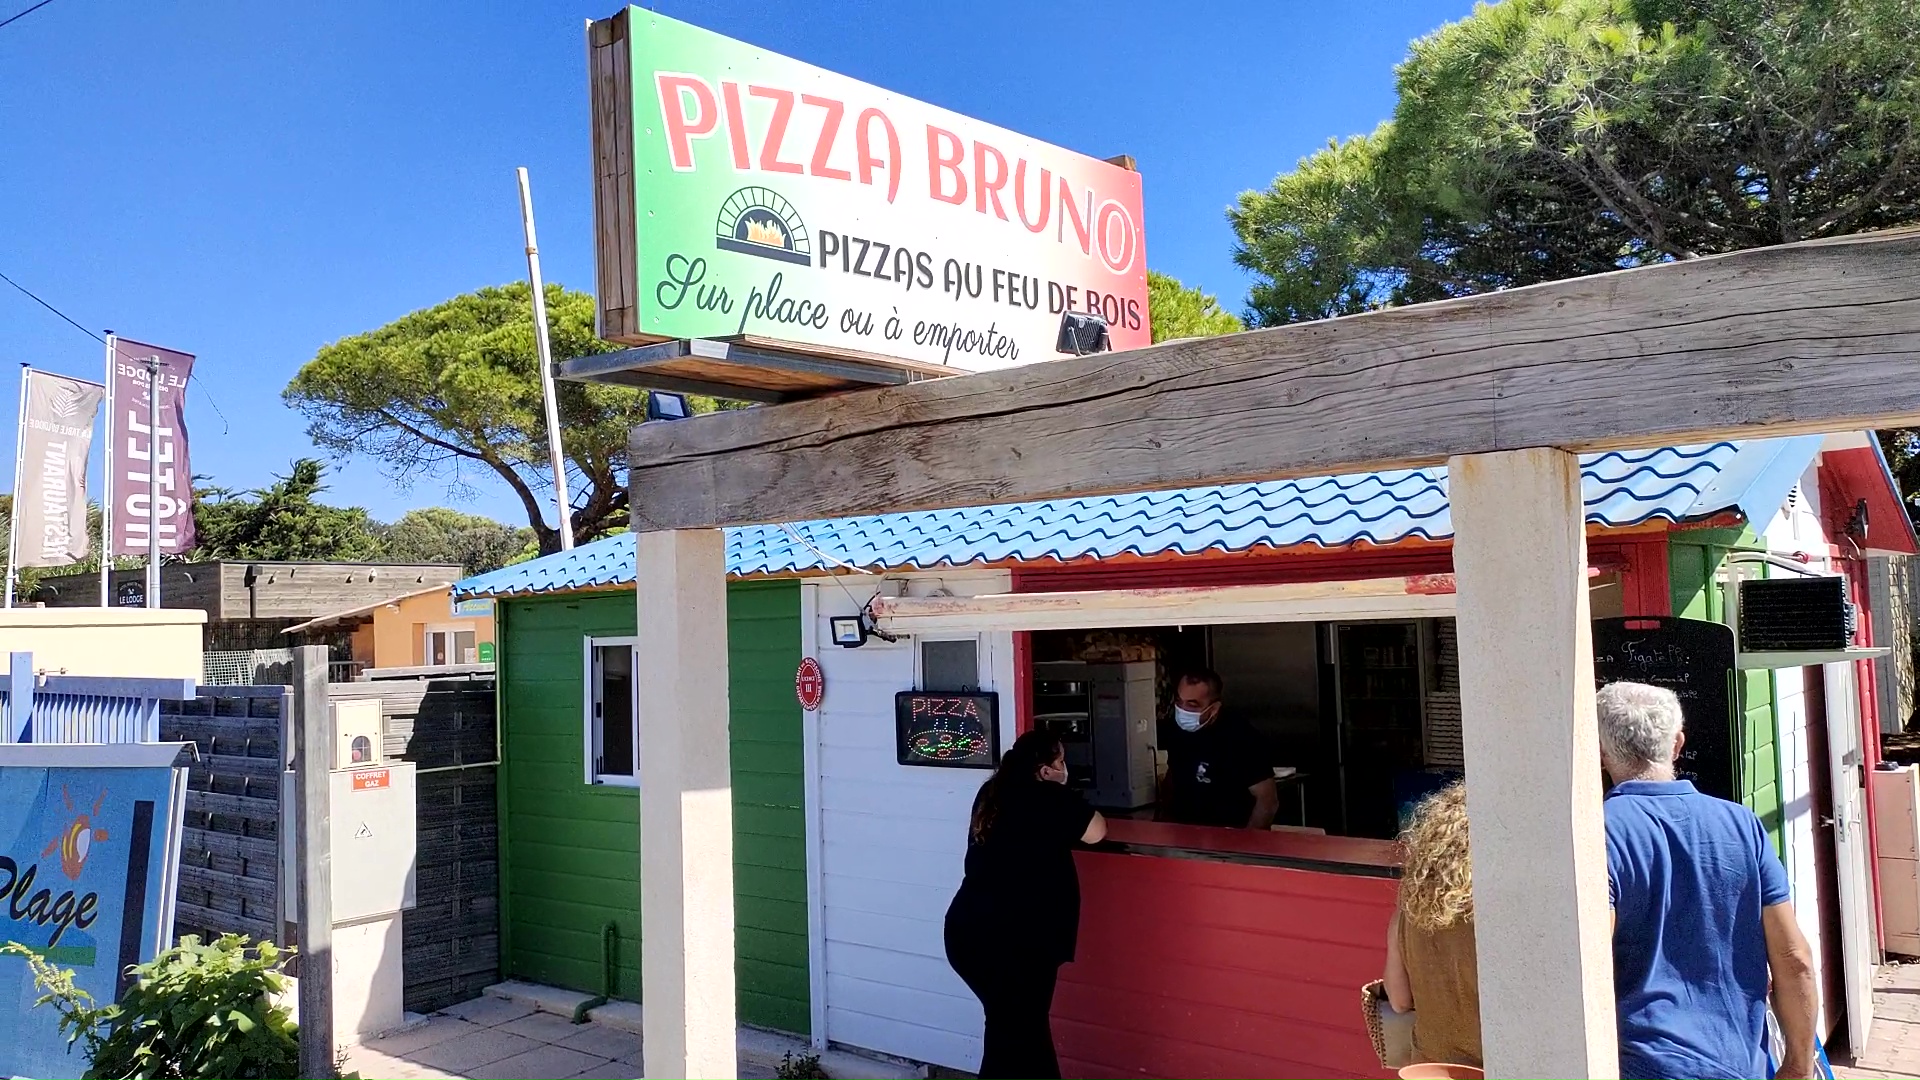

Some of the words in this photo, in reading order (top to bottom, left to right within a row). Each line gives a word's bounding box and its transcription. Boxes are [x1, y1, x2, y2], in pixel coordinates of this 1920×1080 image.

[654, 71, 902, 204] PIZZA
[926, 123, 1137, 275] BRUNO
[818, 229, 934, 292] PIZZAS
[944, 258, 983, 302] AU
[992, 268, 1039, 310] FEU
[1048, 280, 1078, 314] DE
[1086, 289, 1141, 331] BOIS
[656, 253, 734, 315] Sur
[738, 271, 829, 334] place
[840, 308, 875, 336] ou
[884, 305, 903, 340] à
[913, 320, 1019, 365] emporter
[119, 595, 126, 605] LE
[126, 594, 144, 604] LODGE
[911, 697, 980, 723] PIZZA
[355, 771, 387, 781] COFFRET
[364, 780, 380, 788] GAZ
